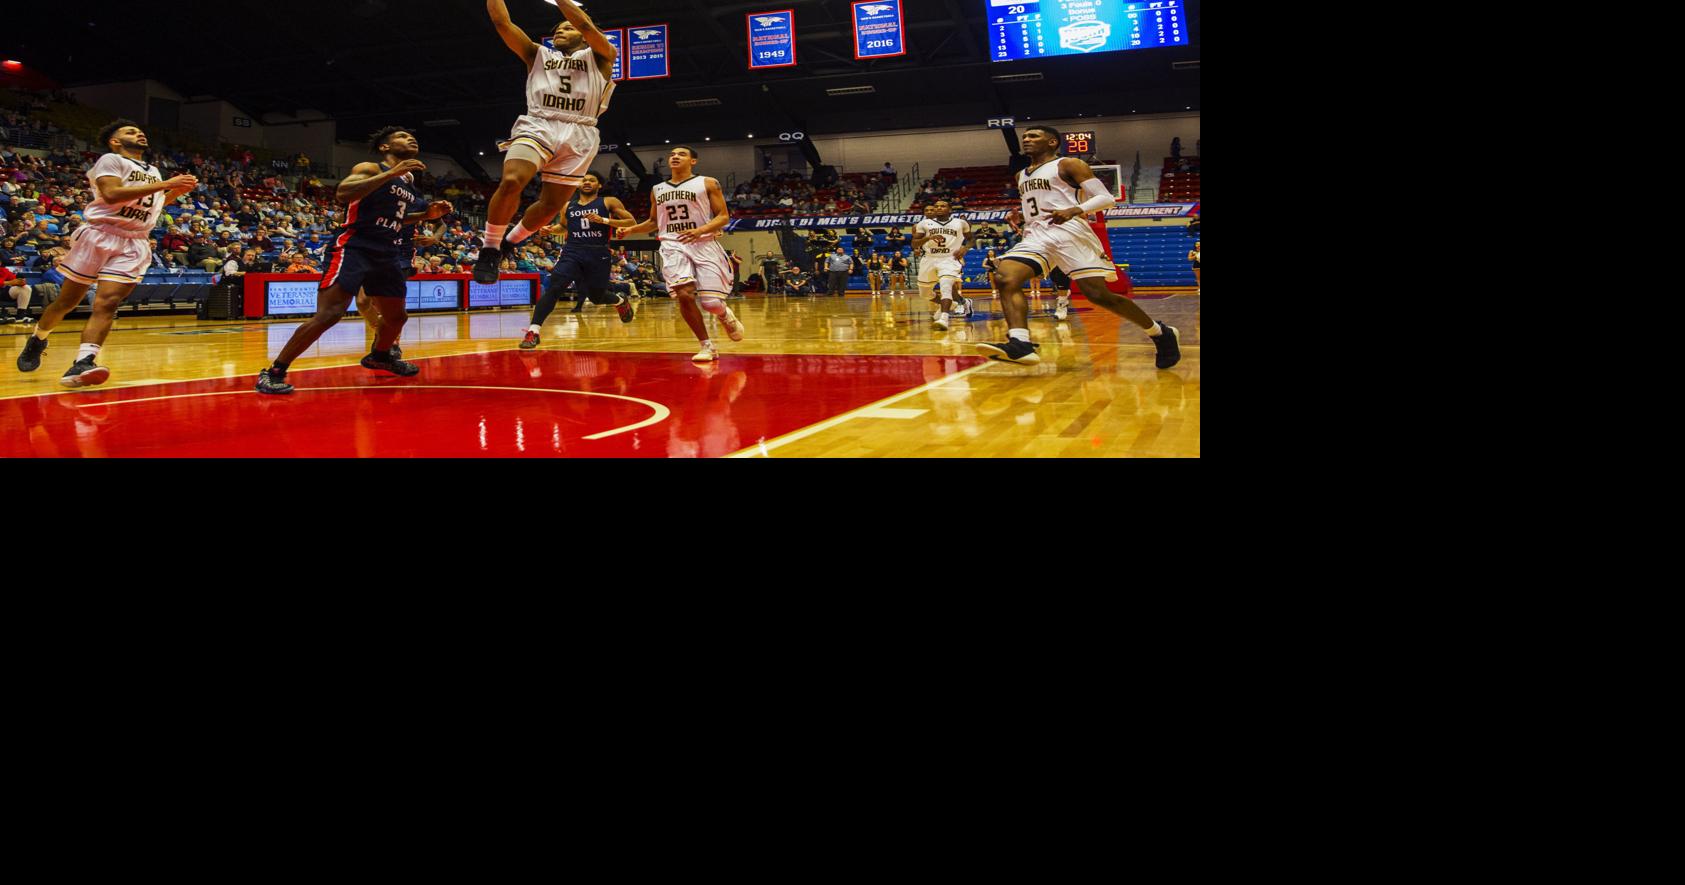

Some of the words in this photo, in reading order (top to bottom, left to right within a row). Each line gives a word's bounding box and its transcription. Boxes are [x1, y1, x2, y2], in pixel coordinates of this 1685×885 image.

[1008, 6, 1025, 14] 20
[867, 39, 893, 48] 2016
[760, 50, 785, 58] 1949
[559, 75, 571, 94] 5
[543, 94, 586, 111] IDAHO
[988, 119, 1014, 127] RR
[779, 132, 804, 140] QQ
[1068, 140, 1088, 152] 28
[272, 160, 288, 168] NN
[657, 190, 697, 205] SOUTHERN
[666, 204, 690, 220] 23
[1026, 197, 1039, 217] 3
[1106, 206, 1181, 217] TOURNAMENT
[570, 209, 599, 217] SOUTH
[580, 217, 590, 229] 0
[817, 216, 860, 226] MEN'S
